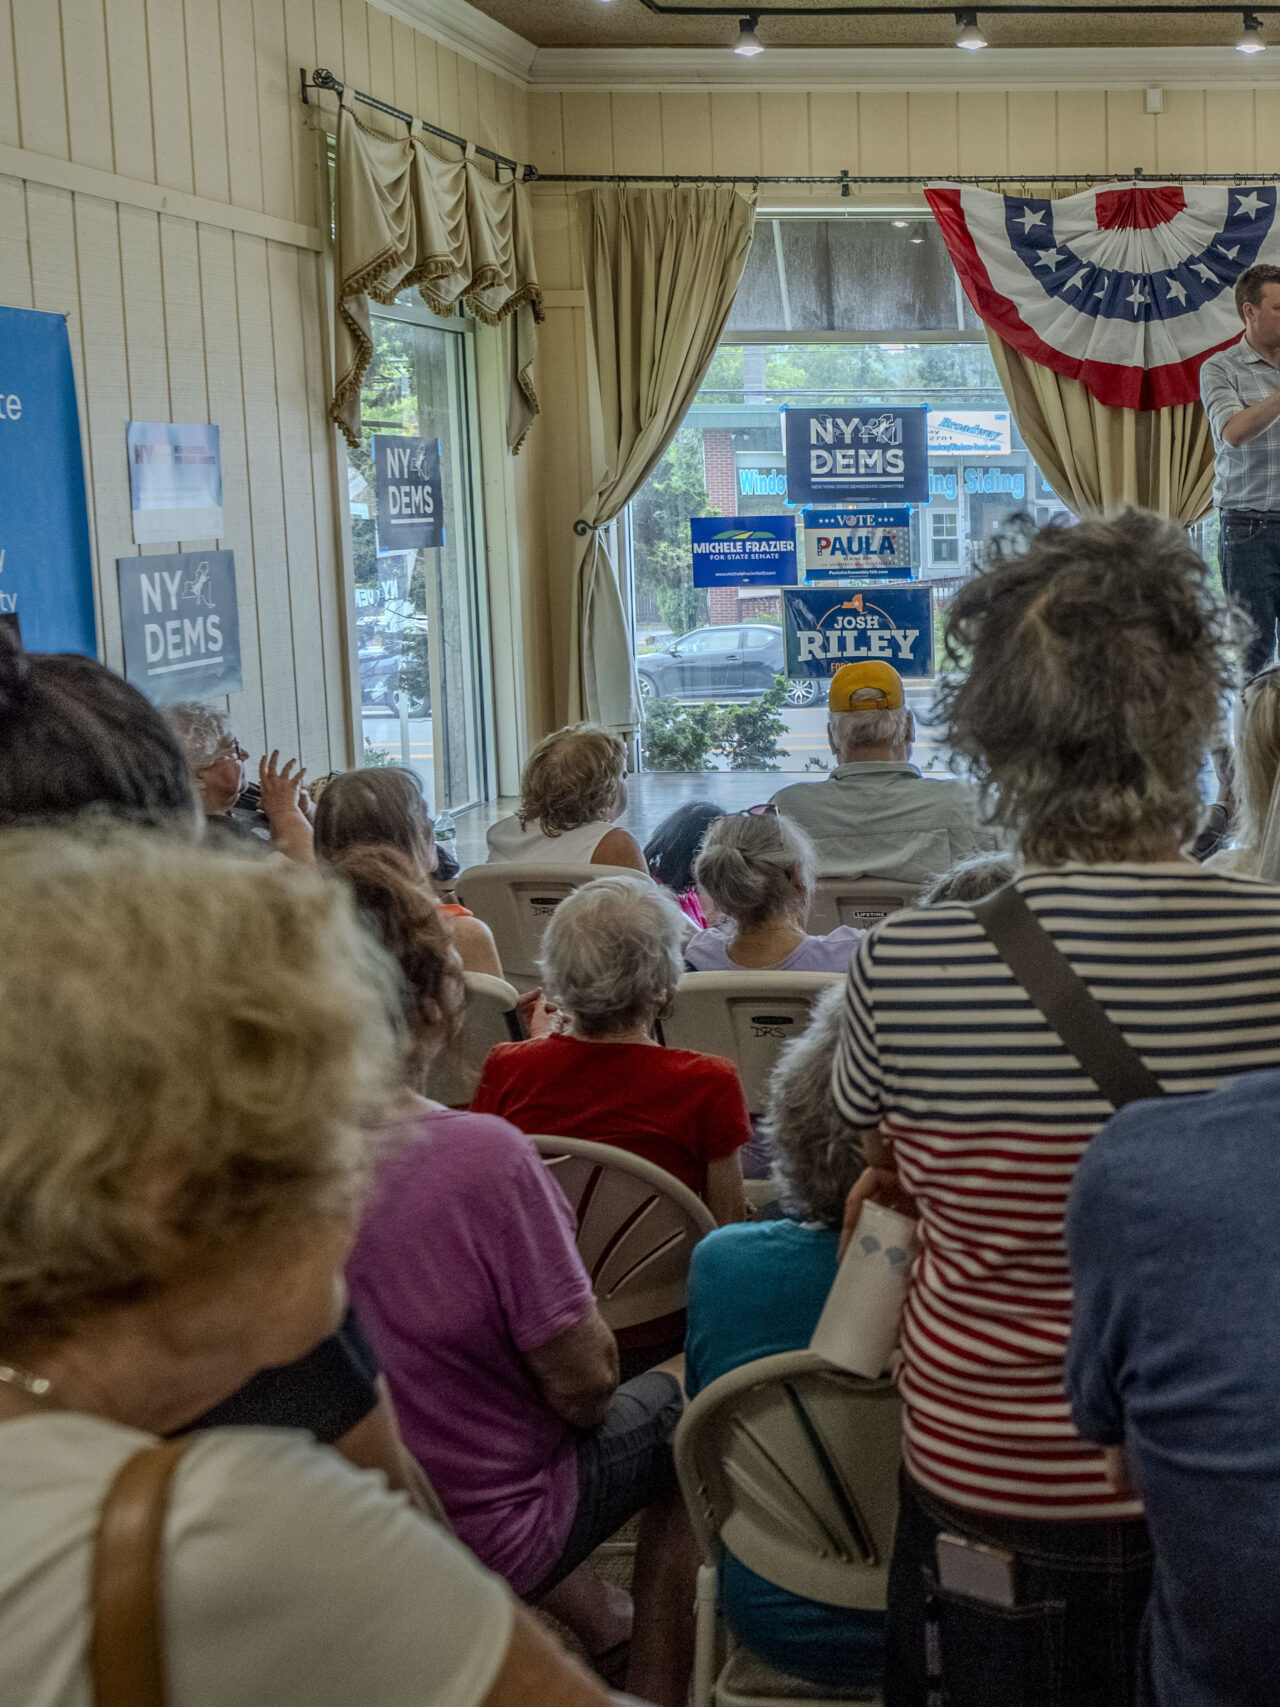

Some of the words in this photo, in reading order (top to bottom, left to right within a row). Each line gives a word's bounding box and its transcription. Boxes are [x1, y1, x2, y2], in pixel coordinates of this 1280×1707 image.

[810, 417, 860, 445] NY
[938, 417, 1003, 441] Broadway
[386, 448, 411, 479] NY
[810, 449, 905, 474] DEMS
[739, 469, 787, 495] Windo
[964, 468, 1025, 500] Siding
[388, 485, 434, 515] DEMS
[836, 514, 876, 526] VOTE
[693, 542, 743, 553] MICHELE
[745, 540, 795, 552] FRAZIER
[816, 536, 896, 556] PAULA
[140, 570, 183, 614] NY
[834, 616, 880, 629] JOSH
[143, 614, 223, 663] DEMS
[796, 629, 920, 662] RILEY
